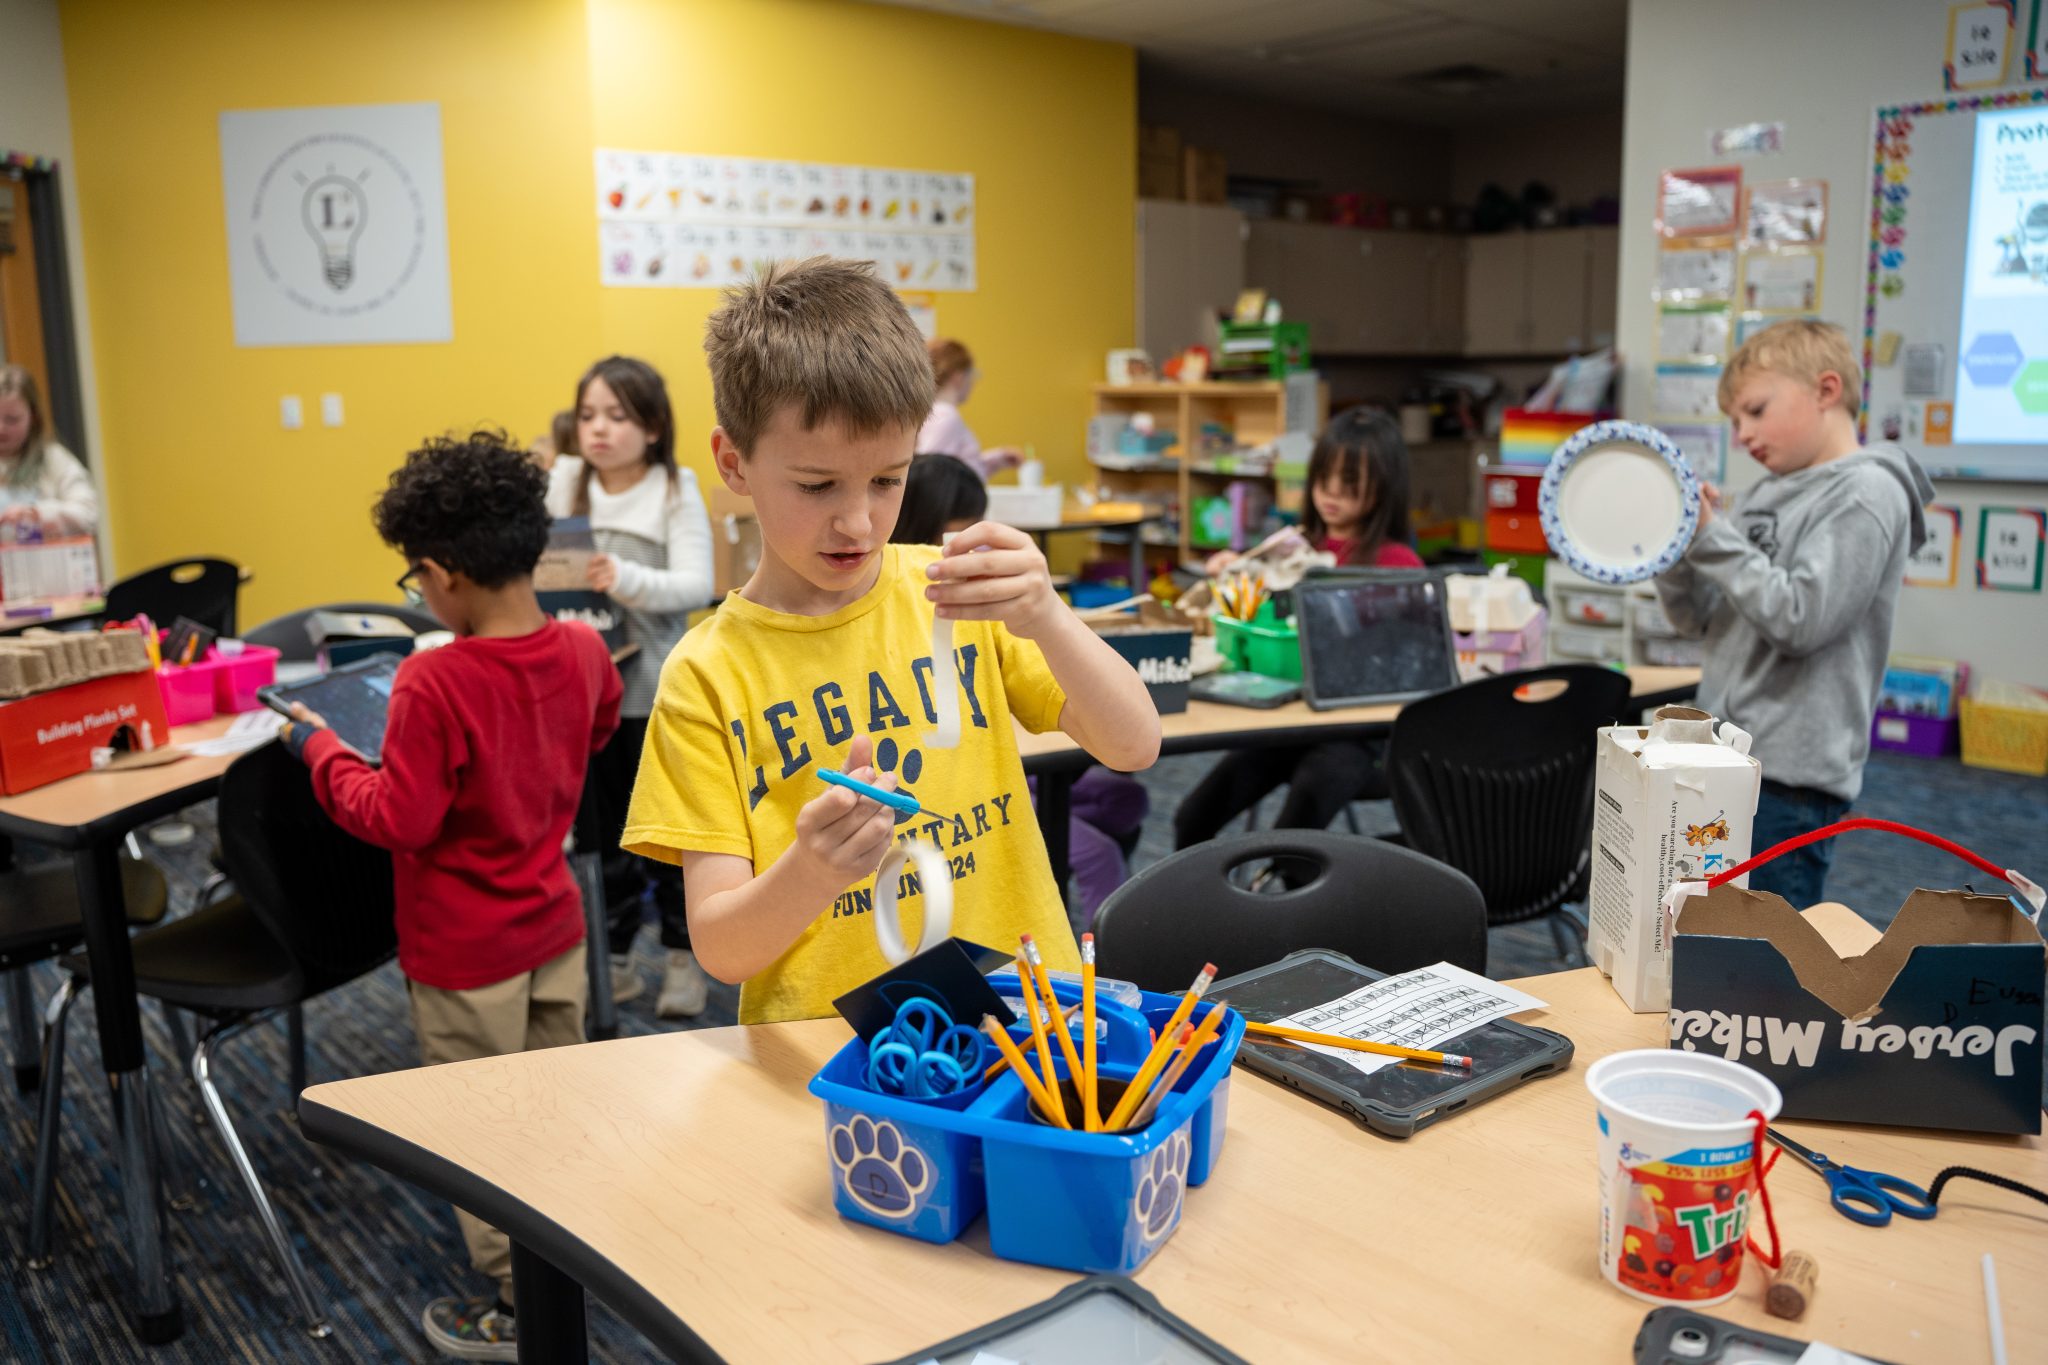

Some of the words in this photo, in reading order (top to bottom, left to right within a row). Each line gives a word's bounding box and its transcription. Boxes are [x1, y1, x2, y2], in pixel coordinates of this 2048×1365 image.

[36, 720, 85, 745] Building
[84, 710, 119, 731] Planks
[118, 703, 138, 719] Set
[1671, 800, 1679, 814] Are
[1669, 815, 1677, 829] you
[1668, 829, 1676, 866] searching
[1668, 867, 1676, 879] for
[1703, 853, 1722, 878] Ki
[1654, 916, 1662, 938] Select
[1653, 939, 1661, 953] Me!
[1841, 1018, 2037, 1077] Jersey
[1665, 1165, 1695, 1178] 25%
[1701, 1166, 1727, 1178] LESS
[1674, 1189, 1750, 1261] Tri
